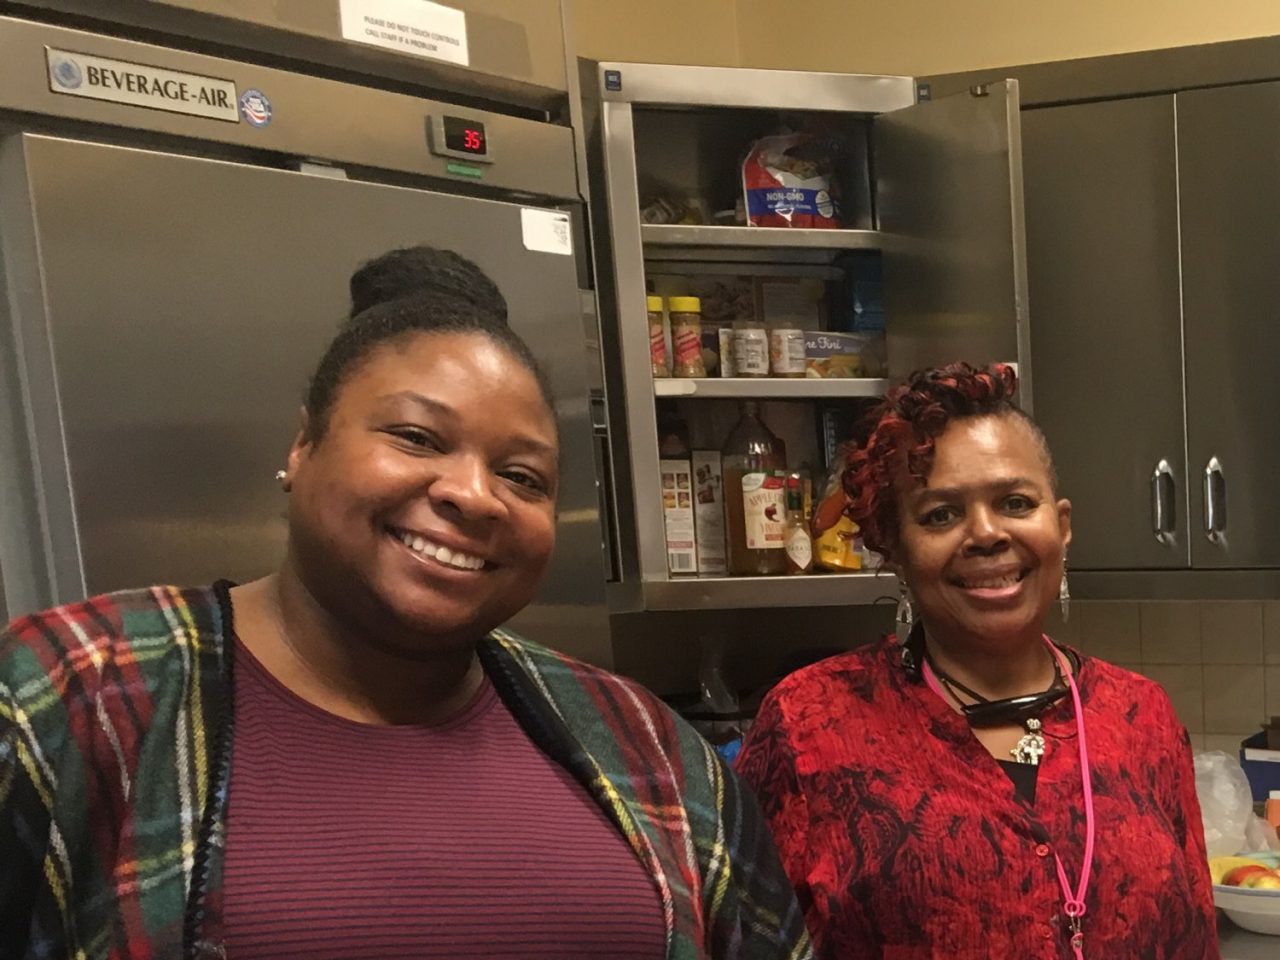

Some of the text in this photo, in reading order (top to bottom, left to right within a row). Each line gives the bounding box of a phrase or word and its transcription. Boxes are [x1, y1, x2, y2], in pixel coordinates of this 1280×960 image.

[363, 15, 385, 28] PLEASE
[386, 21, 396, 30] DO
[397, 23, 410, 33] NOT
[365, 28, 379, 38] CALL
[410, 39, 438, 52] PROBLEM
[766, 192, 805, 202] NON-GMO
